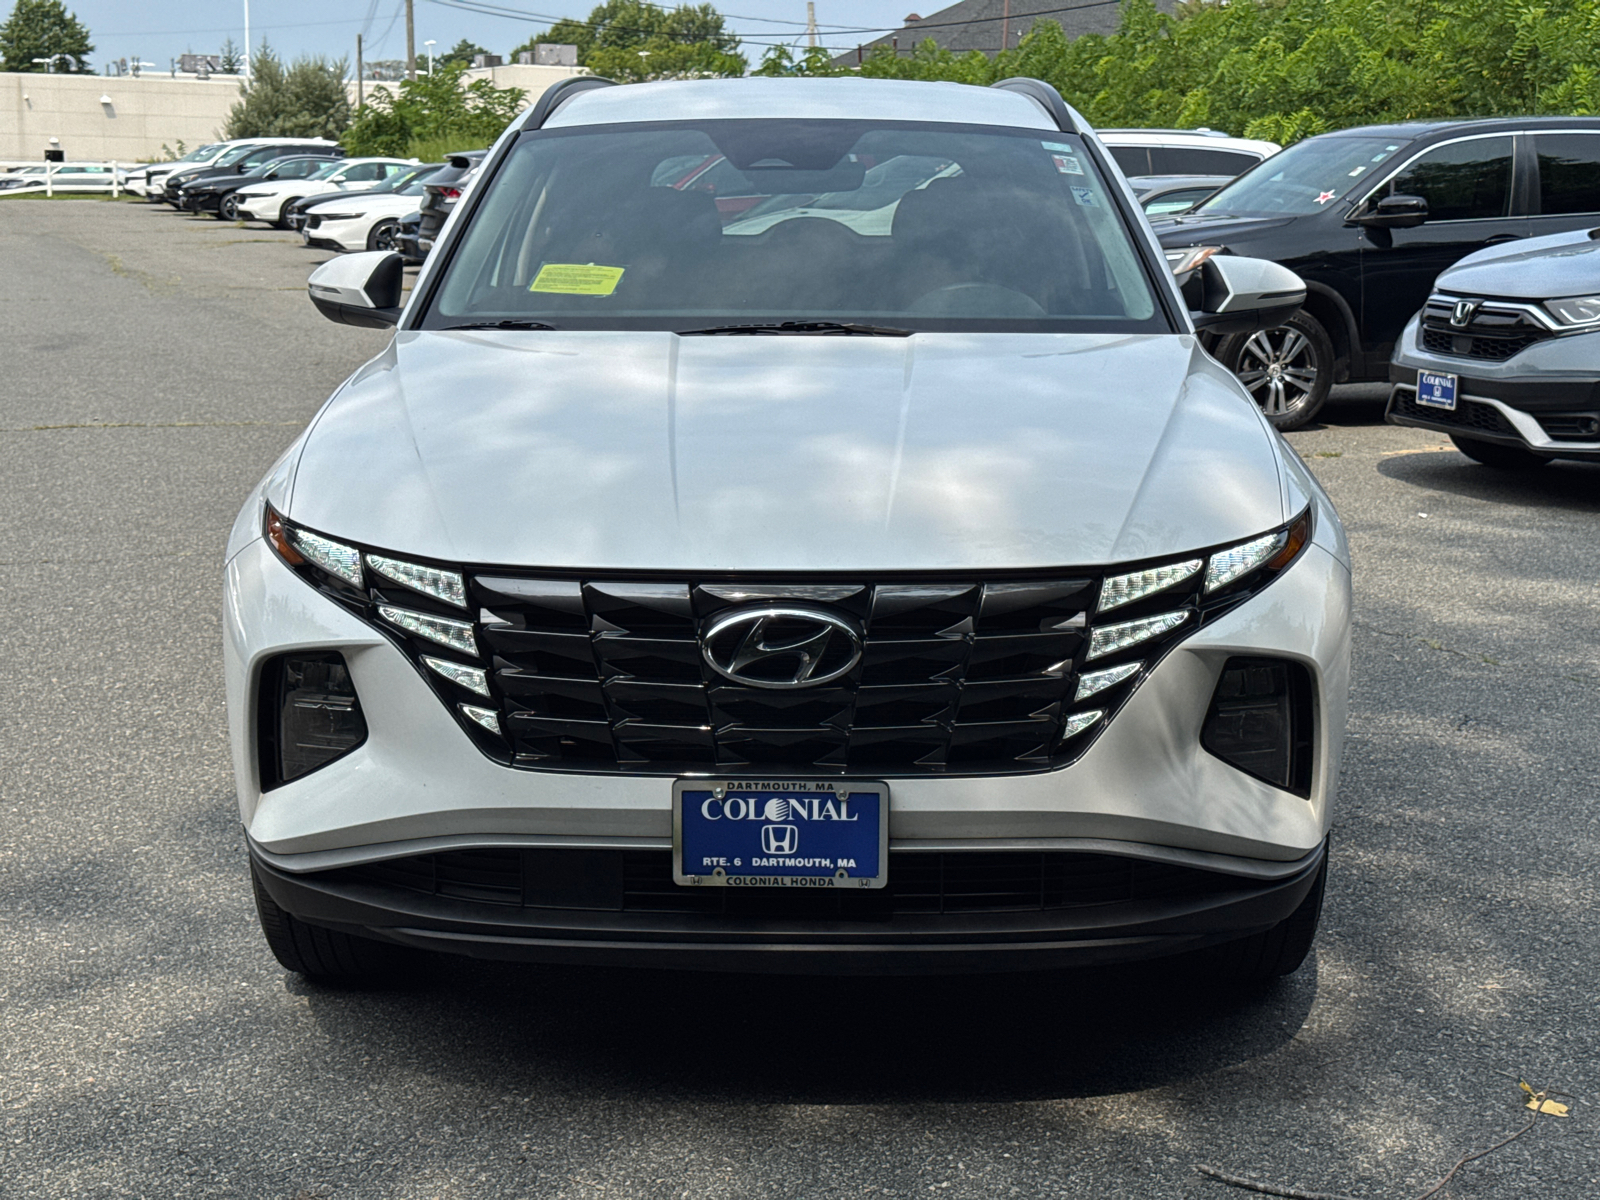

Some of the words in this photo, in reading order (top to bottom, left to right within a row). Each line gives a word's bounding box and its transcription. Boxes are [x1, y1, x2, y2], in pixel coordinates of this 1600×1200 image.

[727, 782, 811, 791] DARTMOUTH,
[815, 783, 834, 791] MA
[701, 798, 859, 821] COLONIAL
[703, 857, 730, 866] RTE.
[734, 858, 742, 866] 6
[752, 858, 834, 869] DARTMOUTH,
[837, 859, 857, 868] MA
[726, 876, 787, 886] COLONIAL
[791, 877, 834, 887] HONDA
